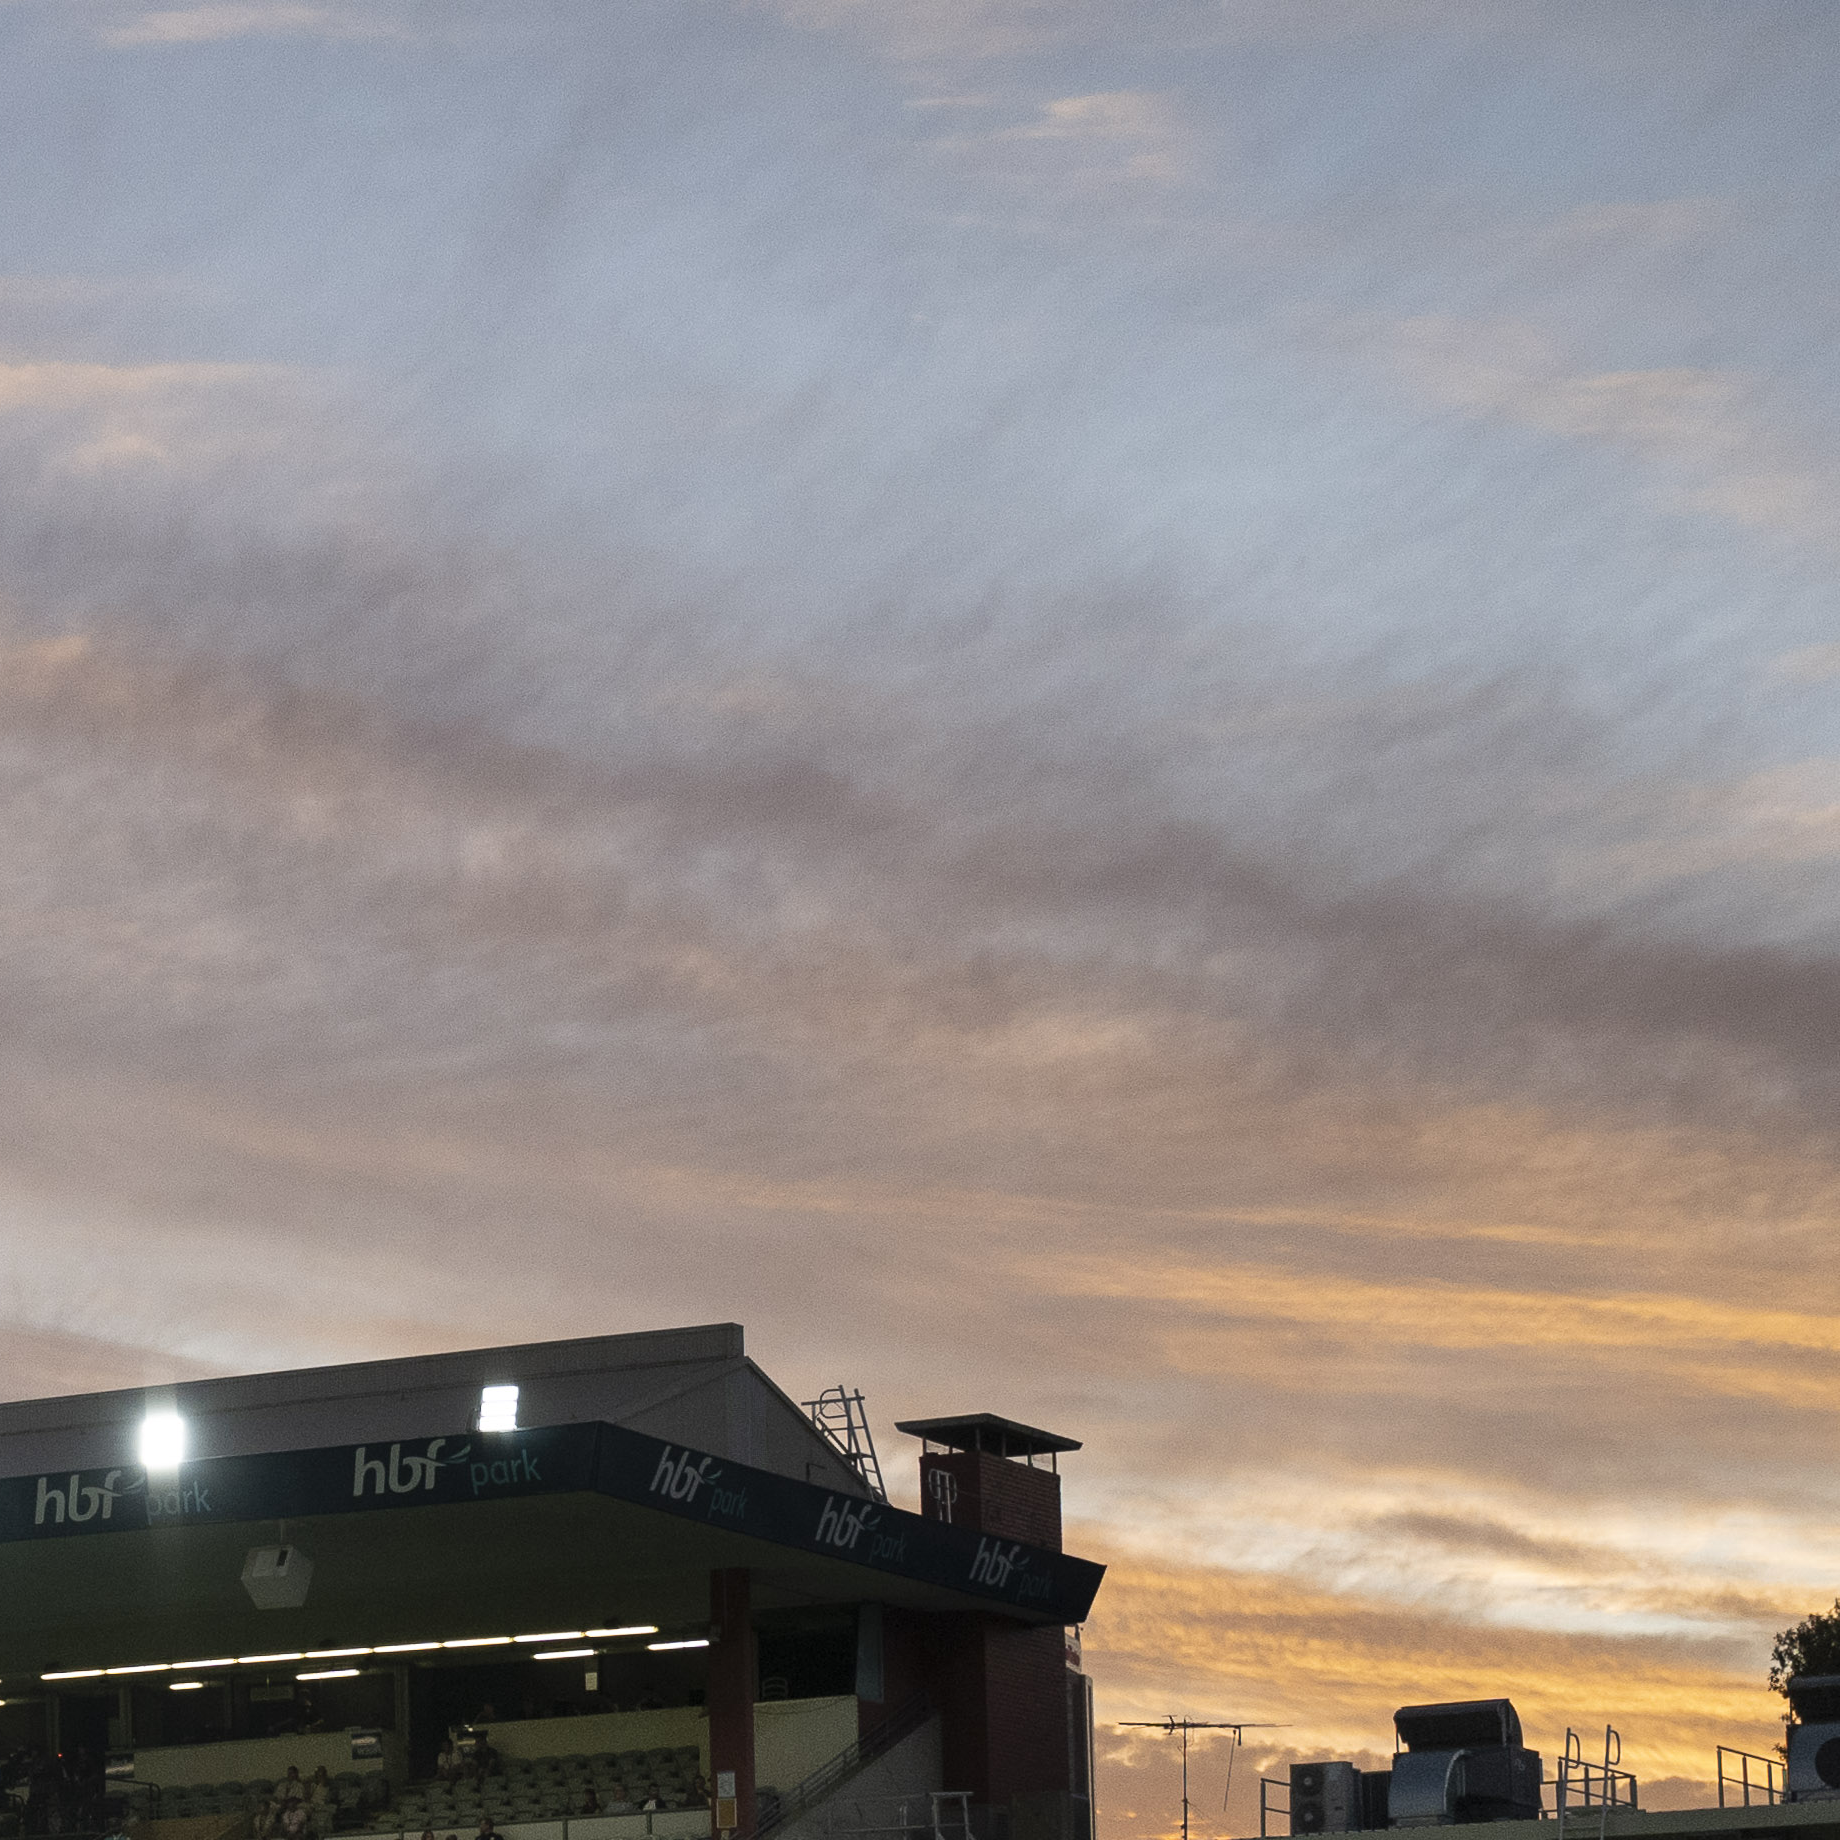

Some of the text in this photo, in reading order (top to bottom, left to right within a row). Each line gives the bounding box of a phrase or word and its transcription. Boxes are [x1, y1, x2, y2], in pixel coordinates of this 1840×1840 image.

[353, 1438, 542, 1496] hbf park
[649, 1446, 747, 1519] hbf park
[35, 1471, 122, 1524] hbf
[816, 1496, 873, 1549] hbf
[969, 1537, 1023, 1588] hbf
